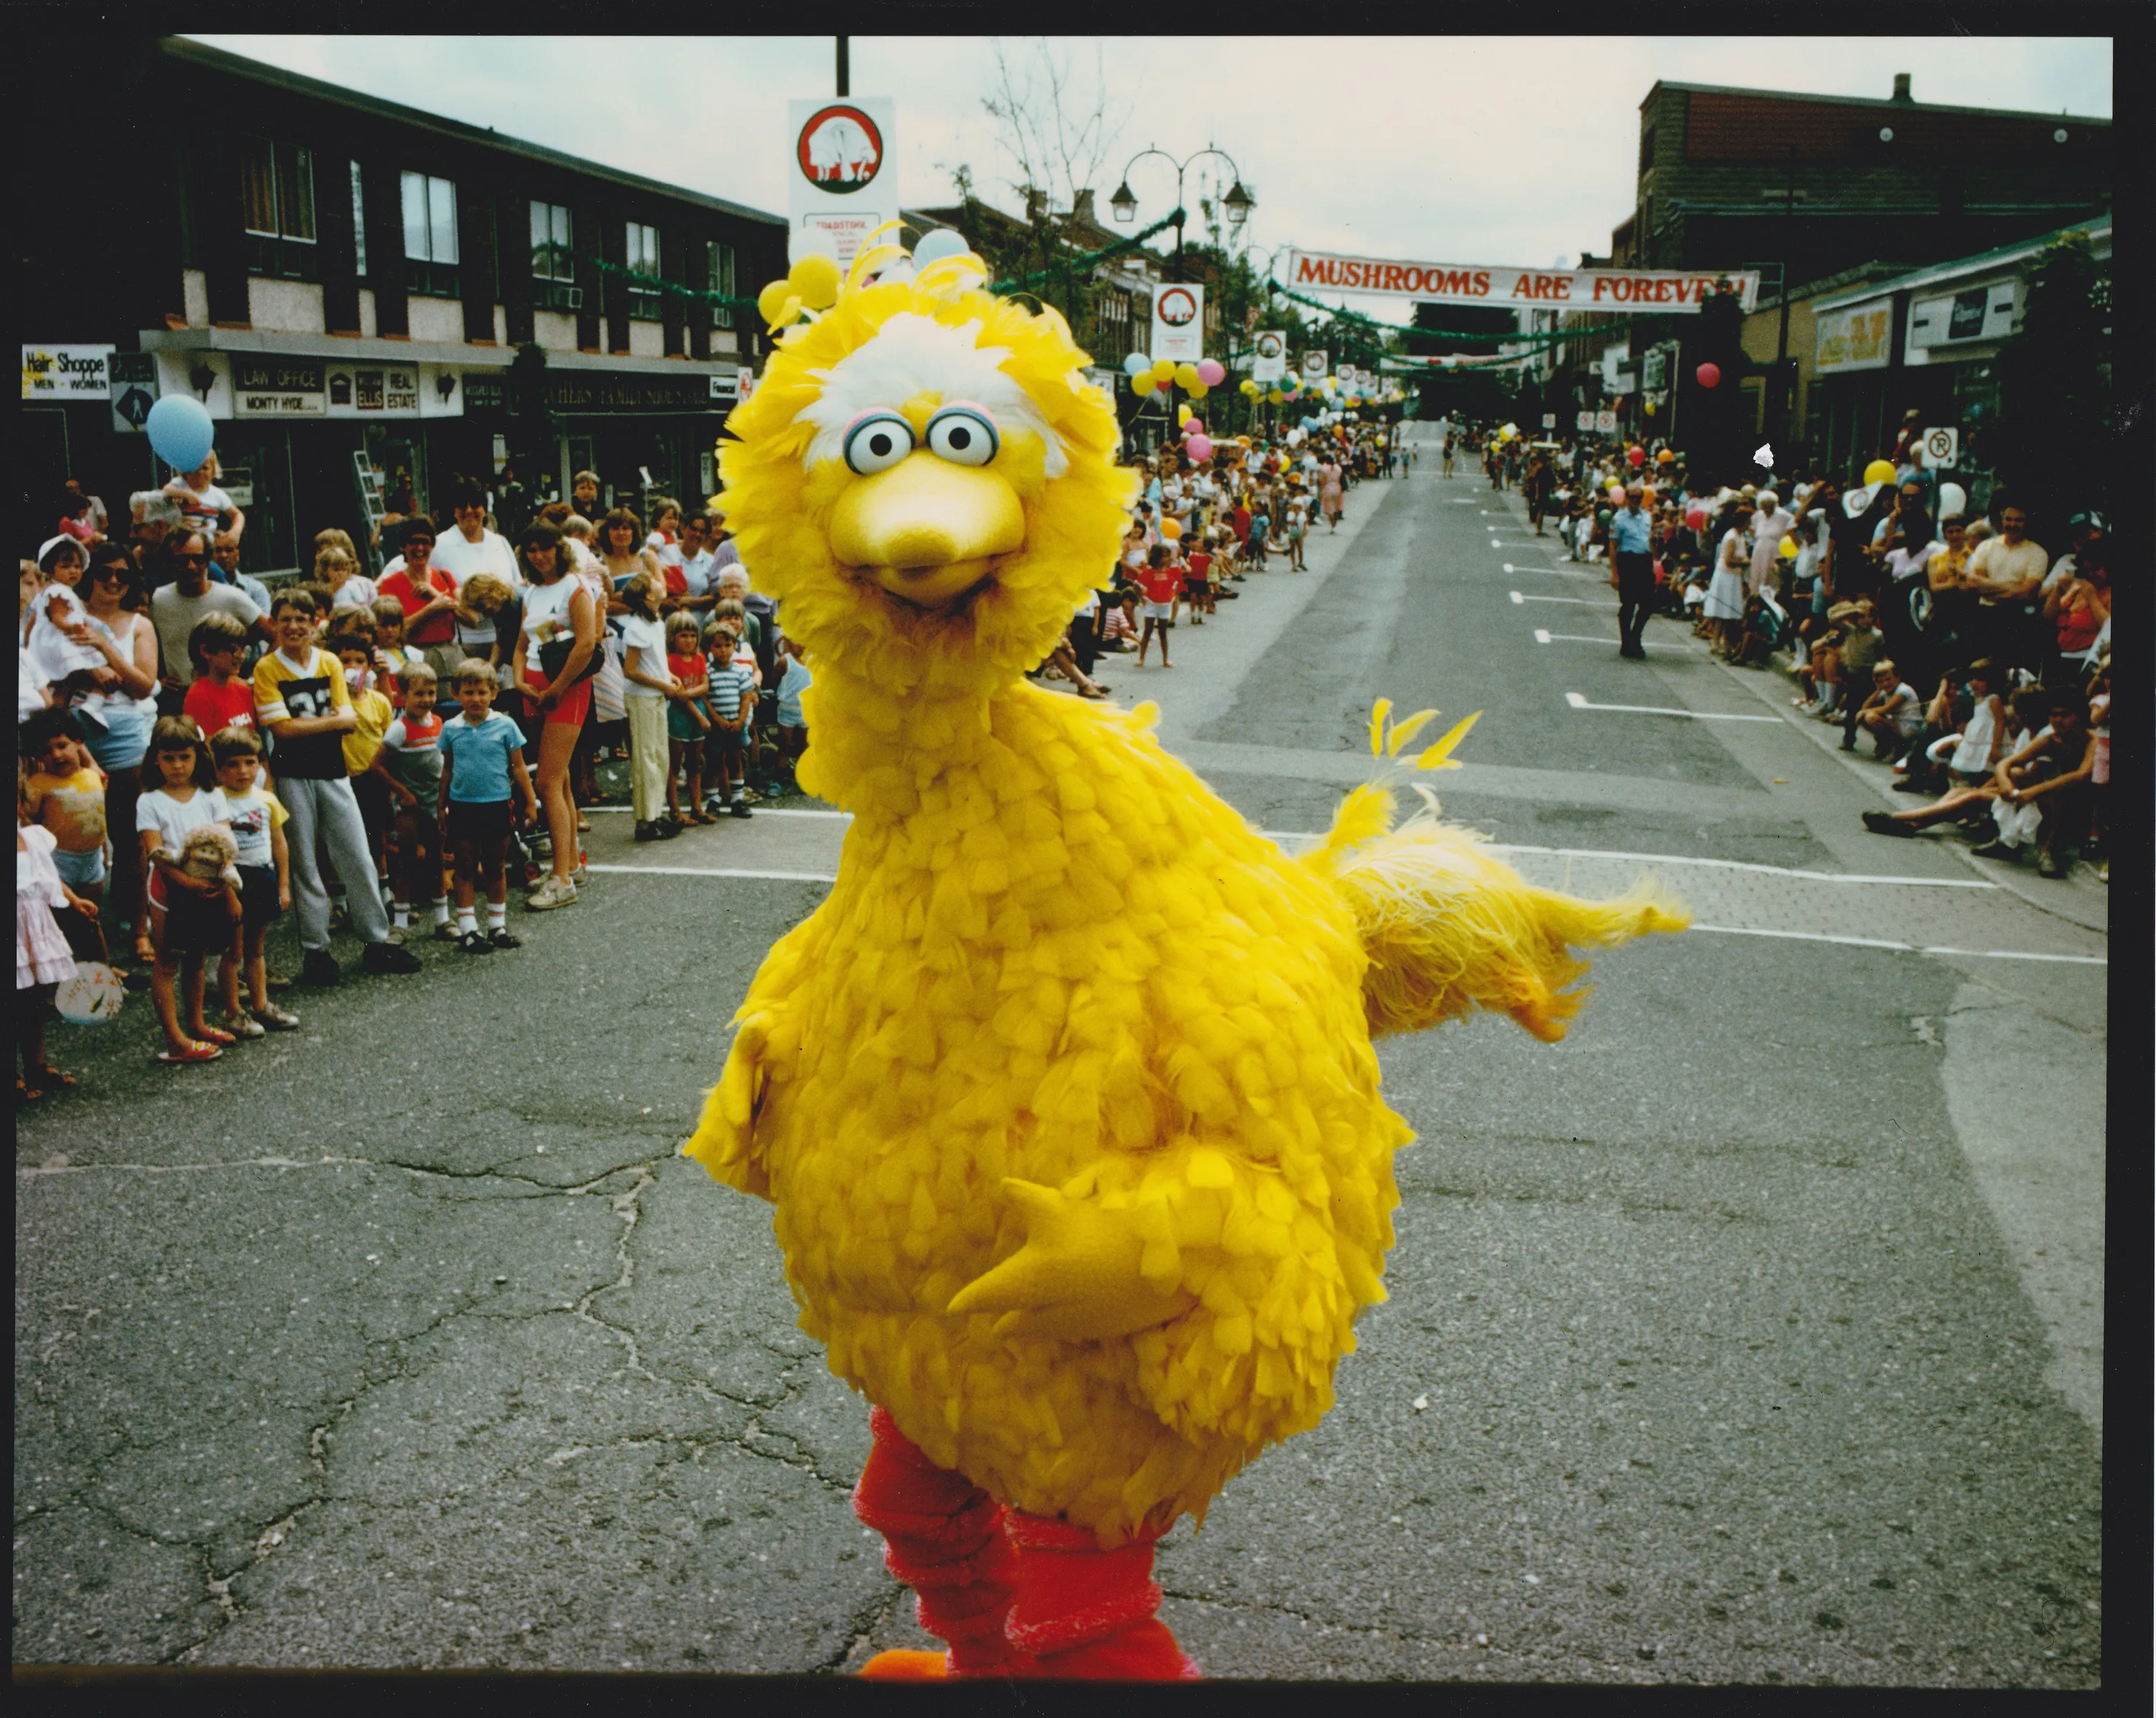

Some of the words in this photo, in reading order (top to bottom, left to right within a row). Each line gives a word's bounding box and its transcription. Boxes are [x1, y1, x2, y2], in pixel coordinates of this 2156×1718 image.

[1297, 257, 1491, 297] MUSHROOMS
[1511, 274, 1574, 300] ARE
[26, 351, 52, 373] Hair
[57, 352, 103, 381] Shoppe
[34, 379, 54, 389] MEN
[70, 379, 106, 390] WOMEN
[243, 369, 268, 386] LAW
[277, 369, 315, 387] OFFICE
[390, 373, 413, 389] REAL
[247, 396, 277, 410] MONTY
[282, 396, 303, 410] HYDE
[358, 390, 382, 407] ELLIS
[388, 393, 416, 408] ESTATE
